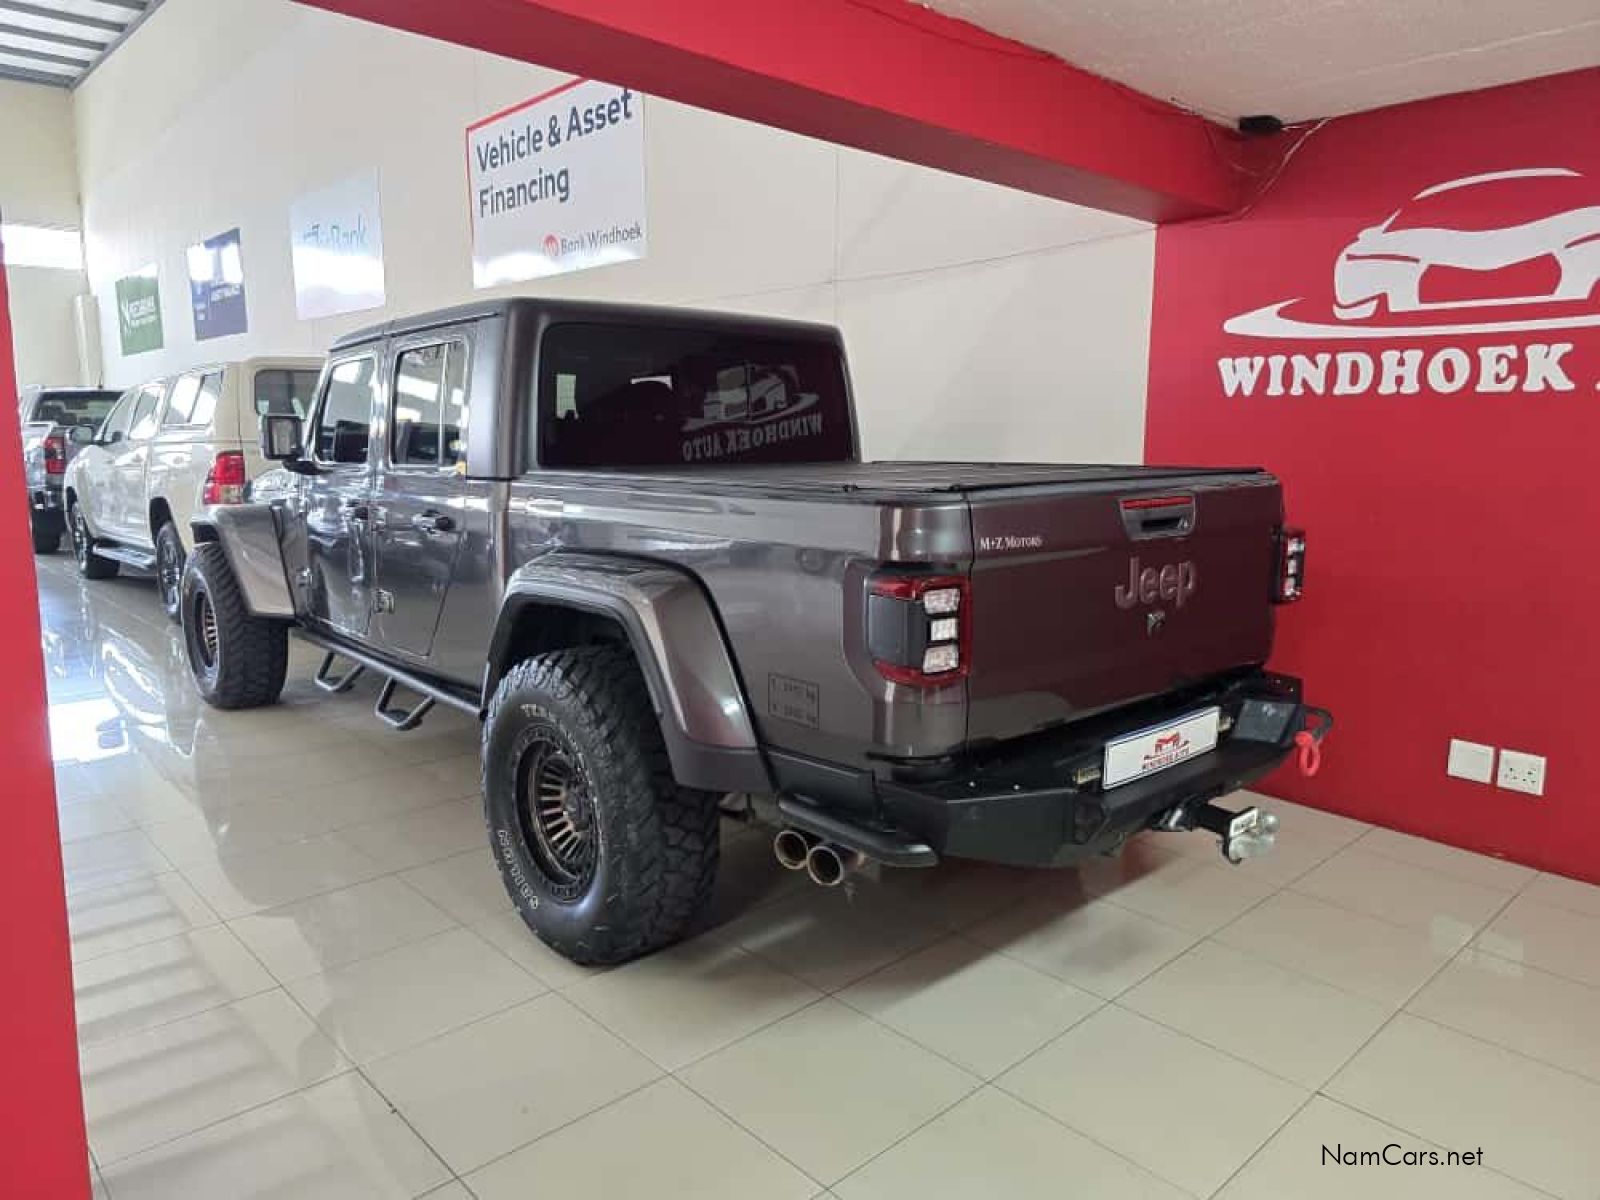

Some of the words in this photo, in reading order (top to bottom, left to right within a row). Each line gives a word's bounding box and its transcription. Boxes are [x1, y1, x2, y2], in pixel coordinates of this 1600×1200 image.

[477, 124, 543, 172] Vehicle
[548, 114, 561, 148] &
[566, 87, 633, 141] Asset
[479, 167, 570, 218] Financing
[561, 234, 585, 256] Bank
[587, 222, 642, 250] Windhoek
[1217, 343, 1575, 398] WINDHOEK
[1114, 556, 1196, 609] Jeep
